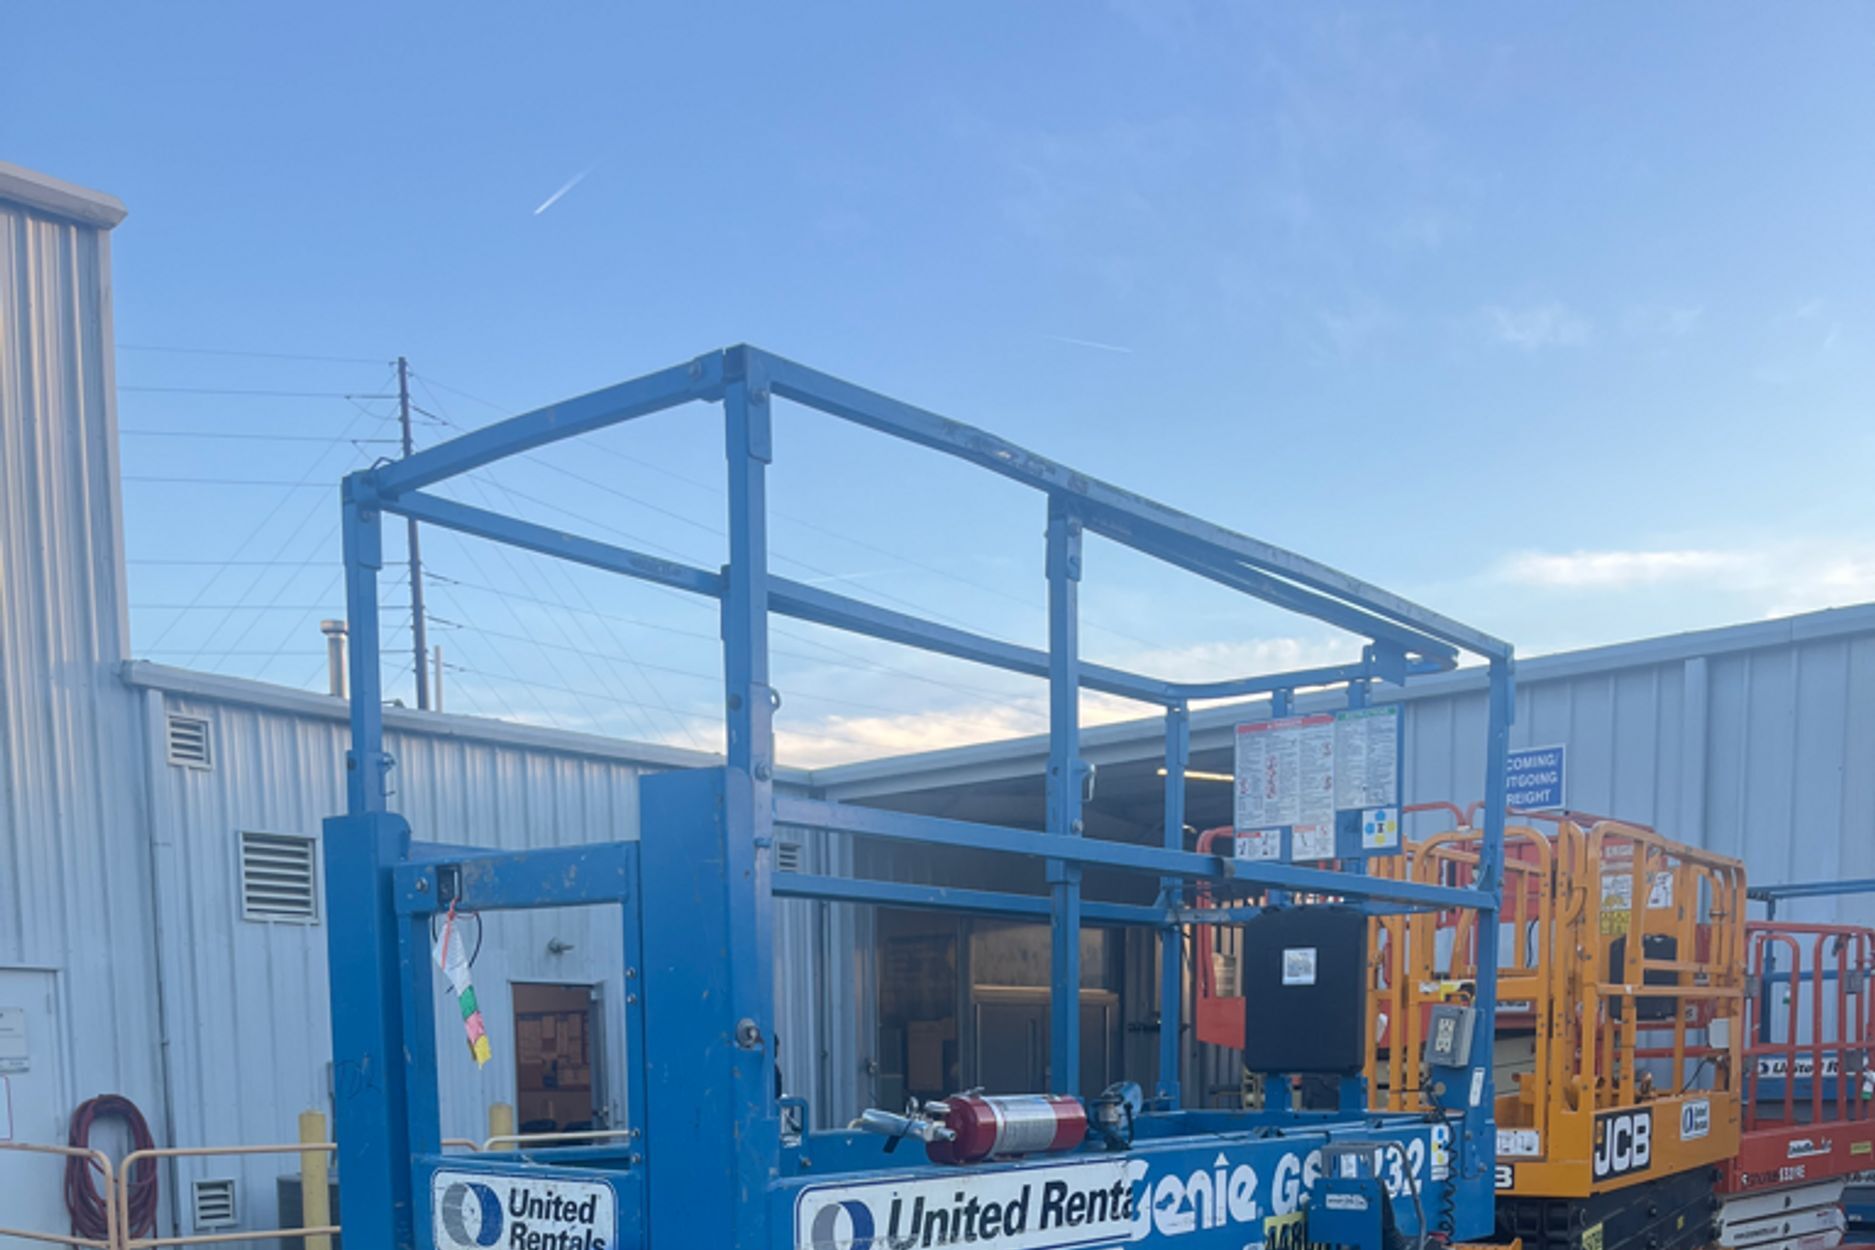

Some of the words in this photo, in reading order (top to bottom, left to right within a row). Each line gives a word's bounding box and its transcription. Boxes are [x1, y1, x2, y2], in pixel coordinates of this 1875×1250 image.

[1506, 771, 1557, 788] TGOING
[1506, 789, 1551, 806] REIGHT
[1594, 1113, 1650, 1176] JCB
[508, 1187, 598, 1225] United
[1039, 1178, 1135, 1231] Renta
[1126, 1152, 1258, 1241] Genie
